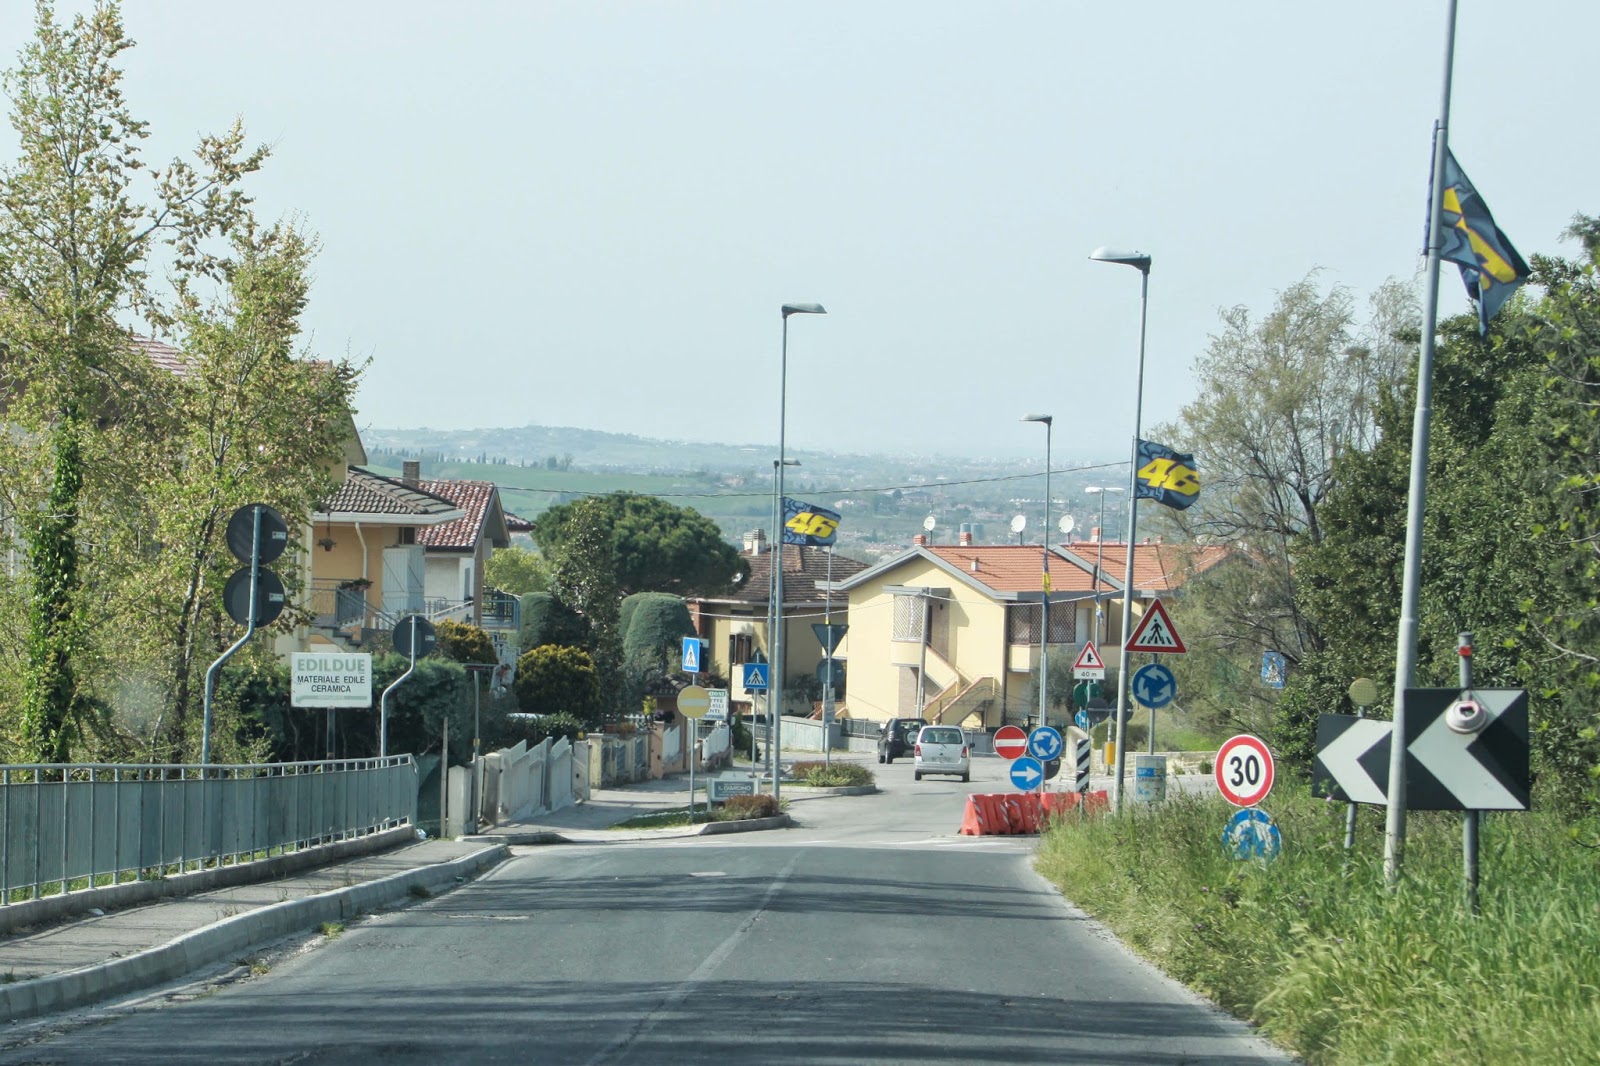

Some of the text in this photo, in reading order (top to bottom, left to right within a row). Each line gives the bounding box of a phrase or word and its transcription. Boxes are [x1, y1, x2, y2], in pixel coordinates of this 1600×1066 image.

[1137, 457, 1200, 496] 46
[785, 512, 839, 538] 46
[297, 659, 365, 671] EDILDUE
[1230, 755, 1260, 786] 30
